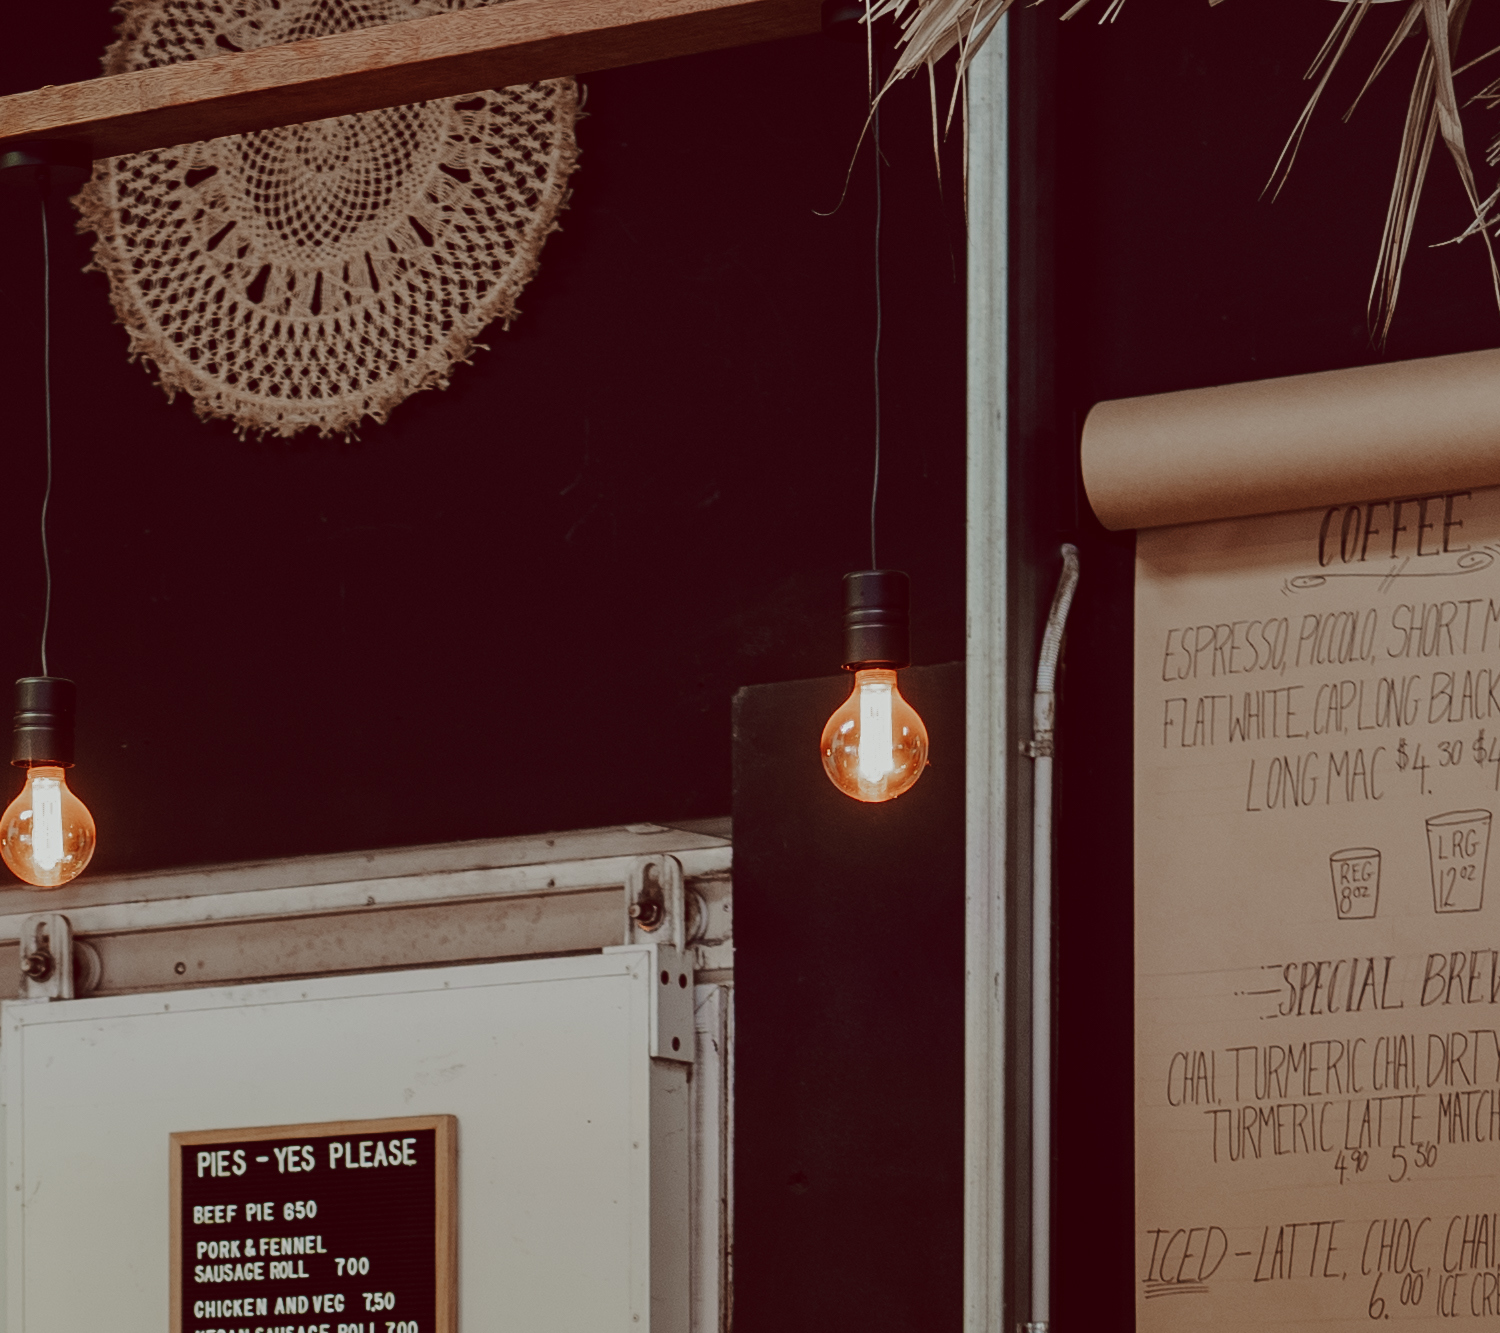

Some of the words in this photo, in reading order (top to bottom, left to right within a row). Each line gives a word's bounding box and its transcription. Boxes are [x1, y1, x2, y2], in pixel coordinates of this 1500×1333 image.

[1318, 490, 1472, 567] COFFEE
[1387, 598, 1483, 658] SHORT
[1163, 695, 1227, 749] FLAT
[1358, 675, 1421, 730] LONG
[1246, 751, 1319, 812] LONG
[1326, 745, 1387, 806] MAC
[1438, 829, 1481, 860] LRG
[1340, 861, 1375, 885] REG
[1278, 956, 1404, 1017] SPECIAL
[1226, 1038, 1367, 1101] TURMERIC
[1203, 1101, 1333, 1163] TURMERIC
[197, 1150, 247, 1178] PIES
[329, 1138, 417, 1169] PLEASE
[193, 1205, 237, 1224] BEEF
[245, 1202, 274, 1221] PIE
[283, 1200, 317, 1221] 650
[194, 1262, 265, 1283] SAUSAGE
[269, 1260, 309, 1279] ROLL
[335, 1257, 370, 1276] 700
[196, 1240, 241, 1260] PORK
[244, 1239, 256, 1257] &
[259, 1235, 327, 1257] FENNEL
[1142, 1225, 1228, 1284] ICED
[194, 1298, 267, 1319] CHICKEN
[274, 1296, 309, 1315] AND
[312, 1294, 345, 1314] VEG
[1436, 1273, 1468, 1317] ICE
